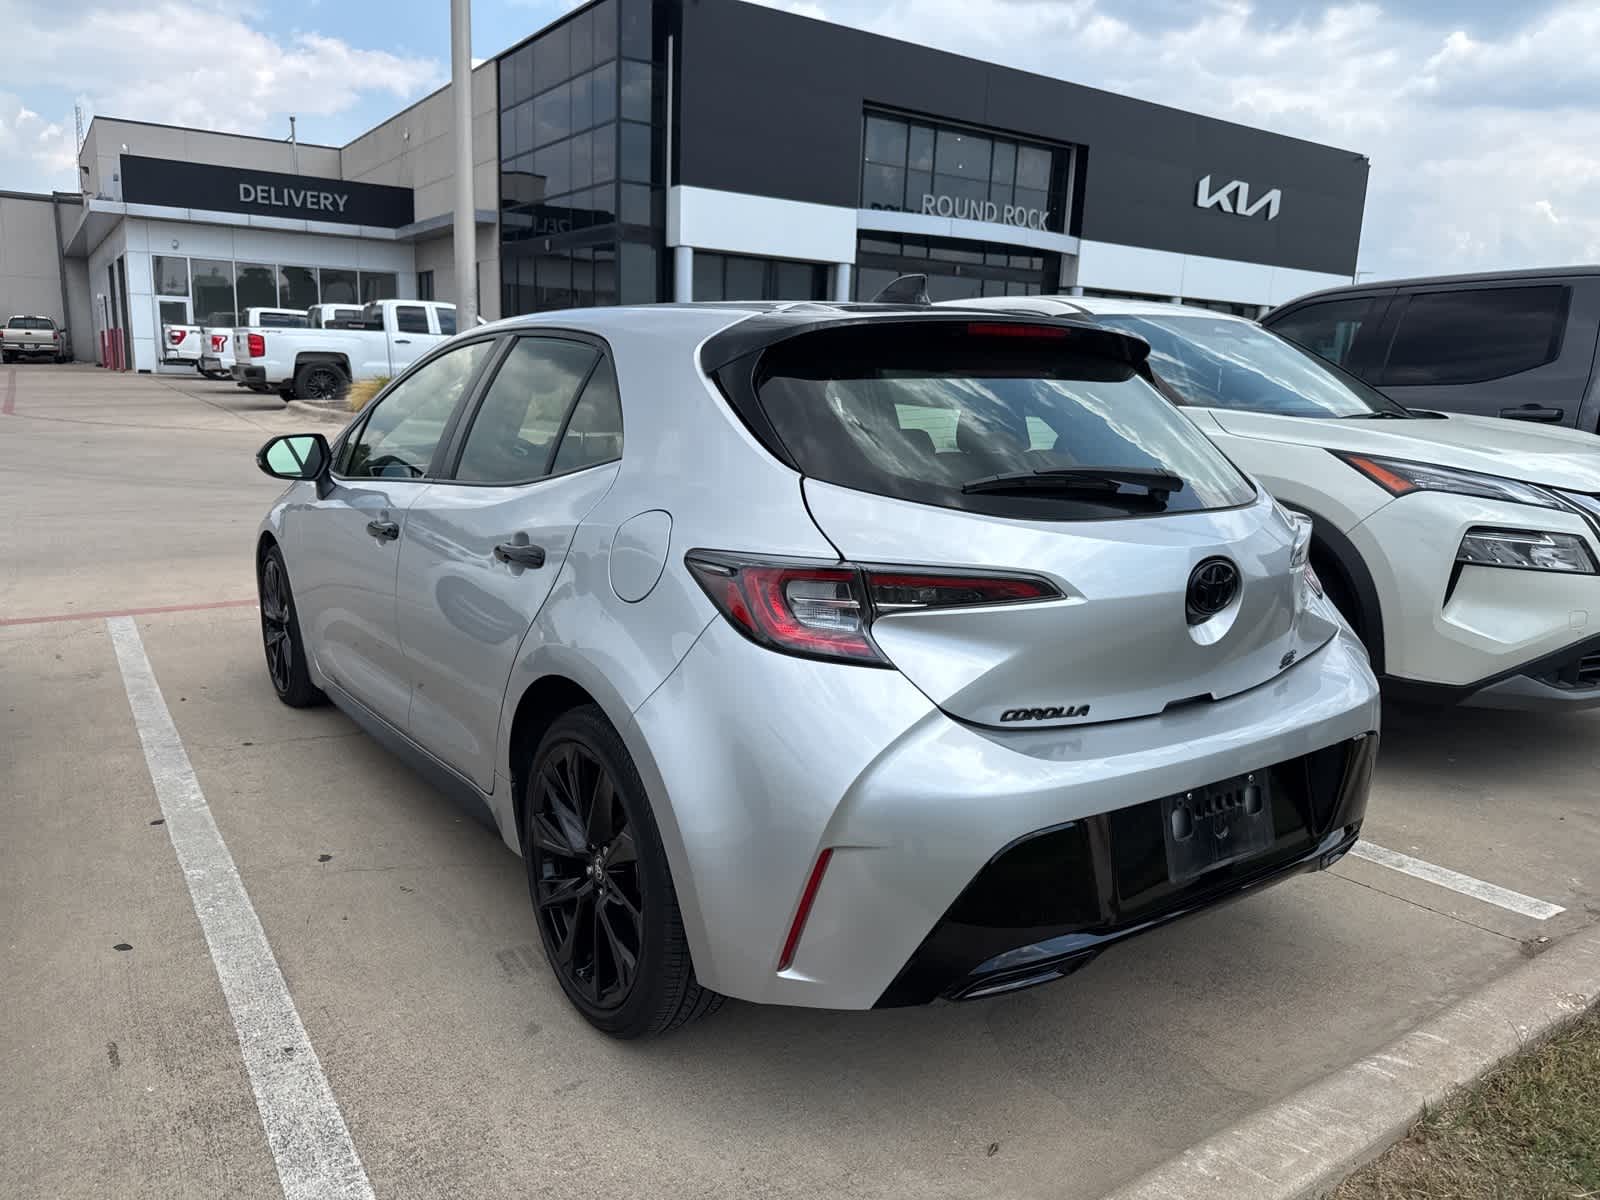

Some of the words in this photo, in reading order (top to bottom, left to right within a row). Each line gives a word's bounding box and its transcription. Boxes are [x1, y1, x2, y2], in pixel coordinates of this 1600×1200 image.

[239, 183, 349, 213] DELIVERY
[921, 193, 998, 223] ROUND
[1002, 204, 1050, 232] ROCK
[1000, 703, 1091, 722] COROLLA
